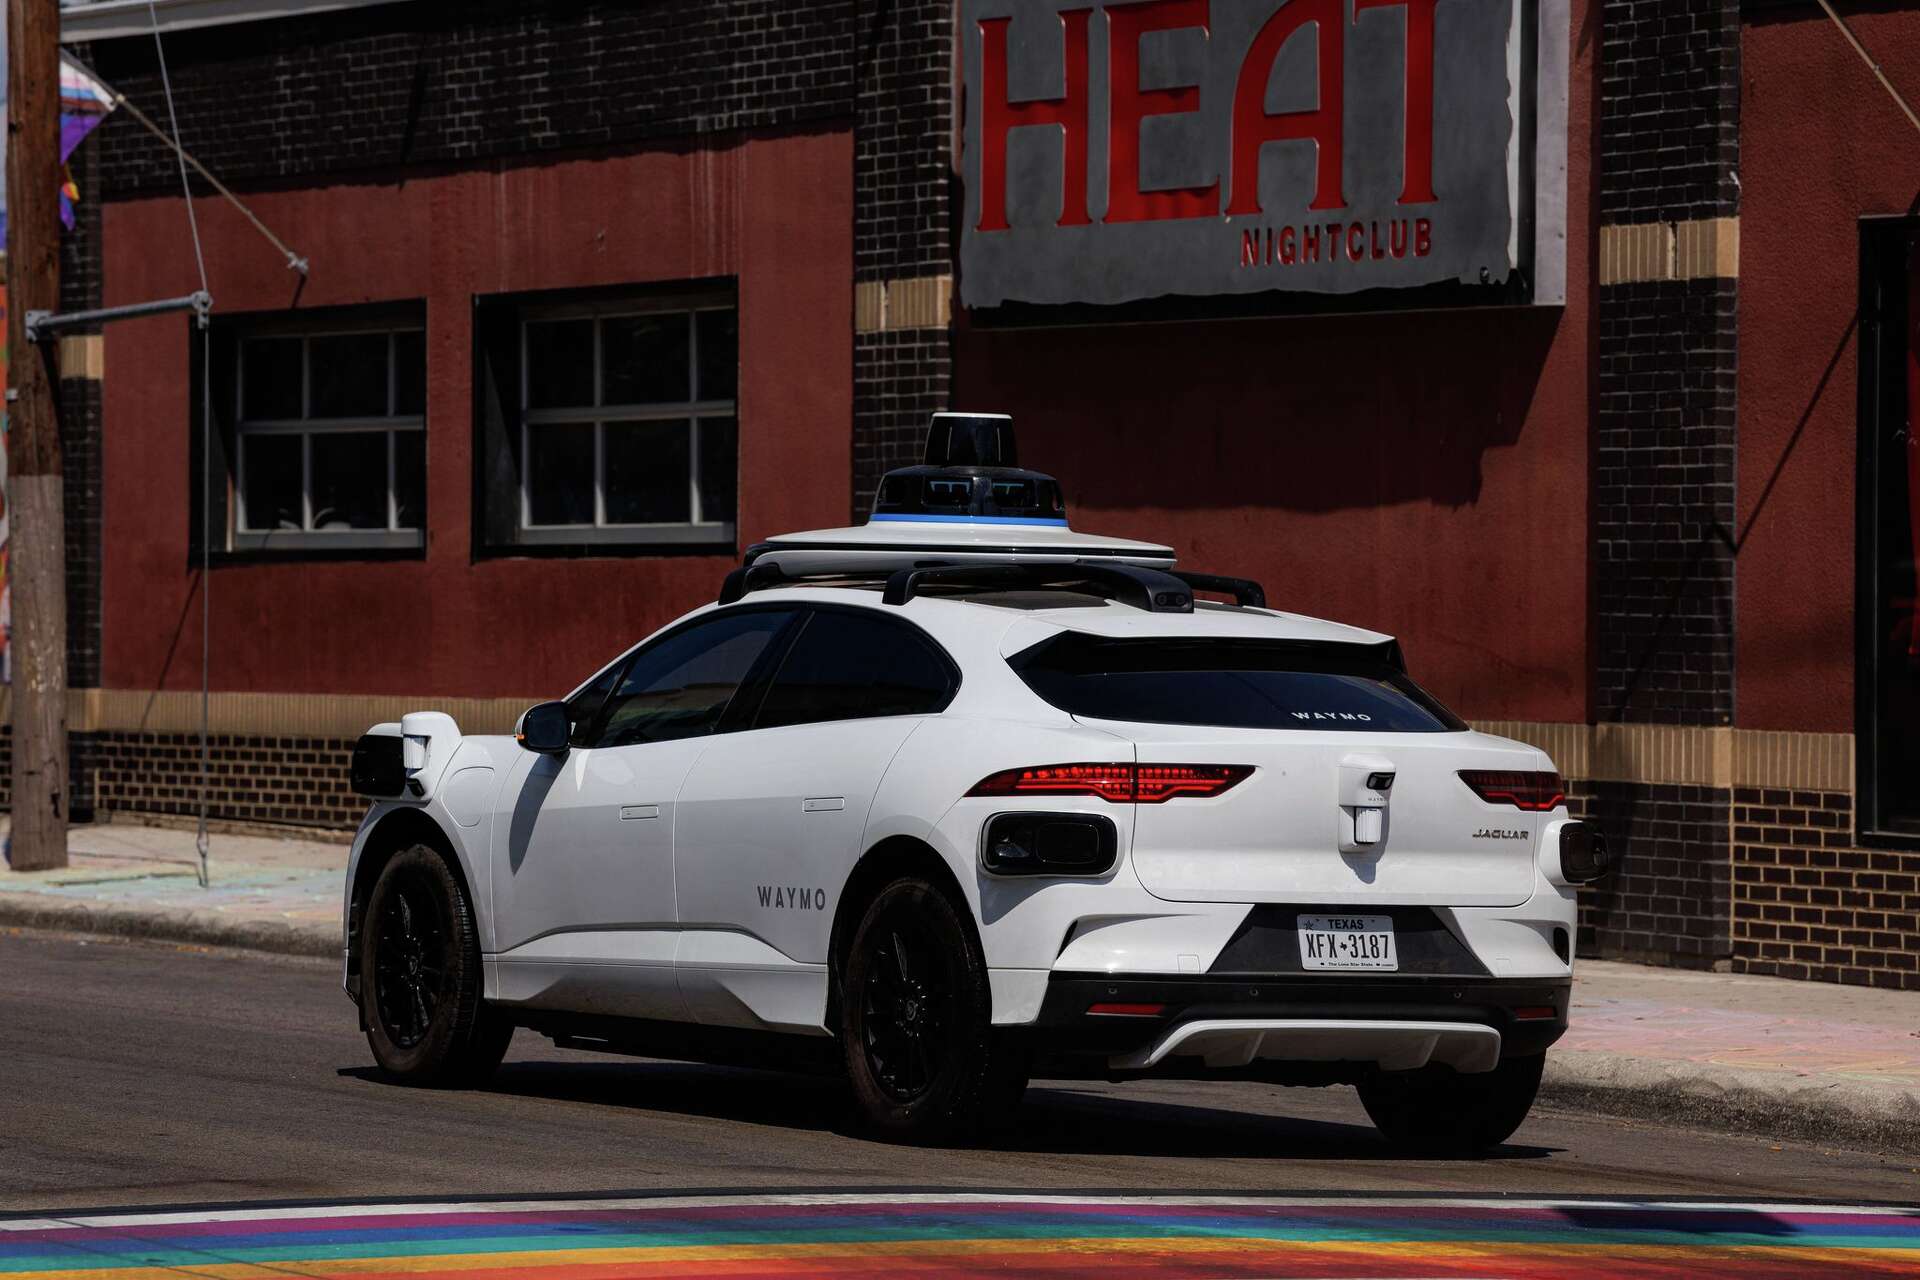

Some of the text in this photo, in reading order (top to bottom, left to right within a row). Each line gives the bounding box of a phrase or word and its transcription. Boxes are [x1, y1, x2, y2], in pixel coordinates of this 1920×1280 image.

[974, 0, 1439, 232] HEAT
[1240, 218, 1432, 268] NIGHTCLUB
[1291, 712, 1371, 721] WAYMO
[1472, 829, 1529, 840] JAGUAR
[757, 885, 826, 911] WAYMO
[1327, 918, 1364, 930] TEXAS
